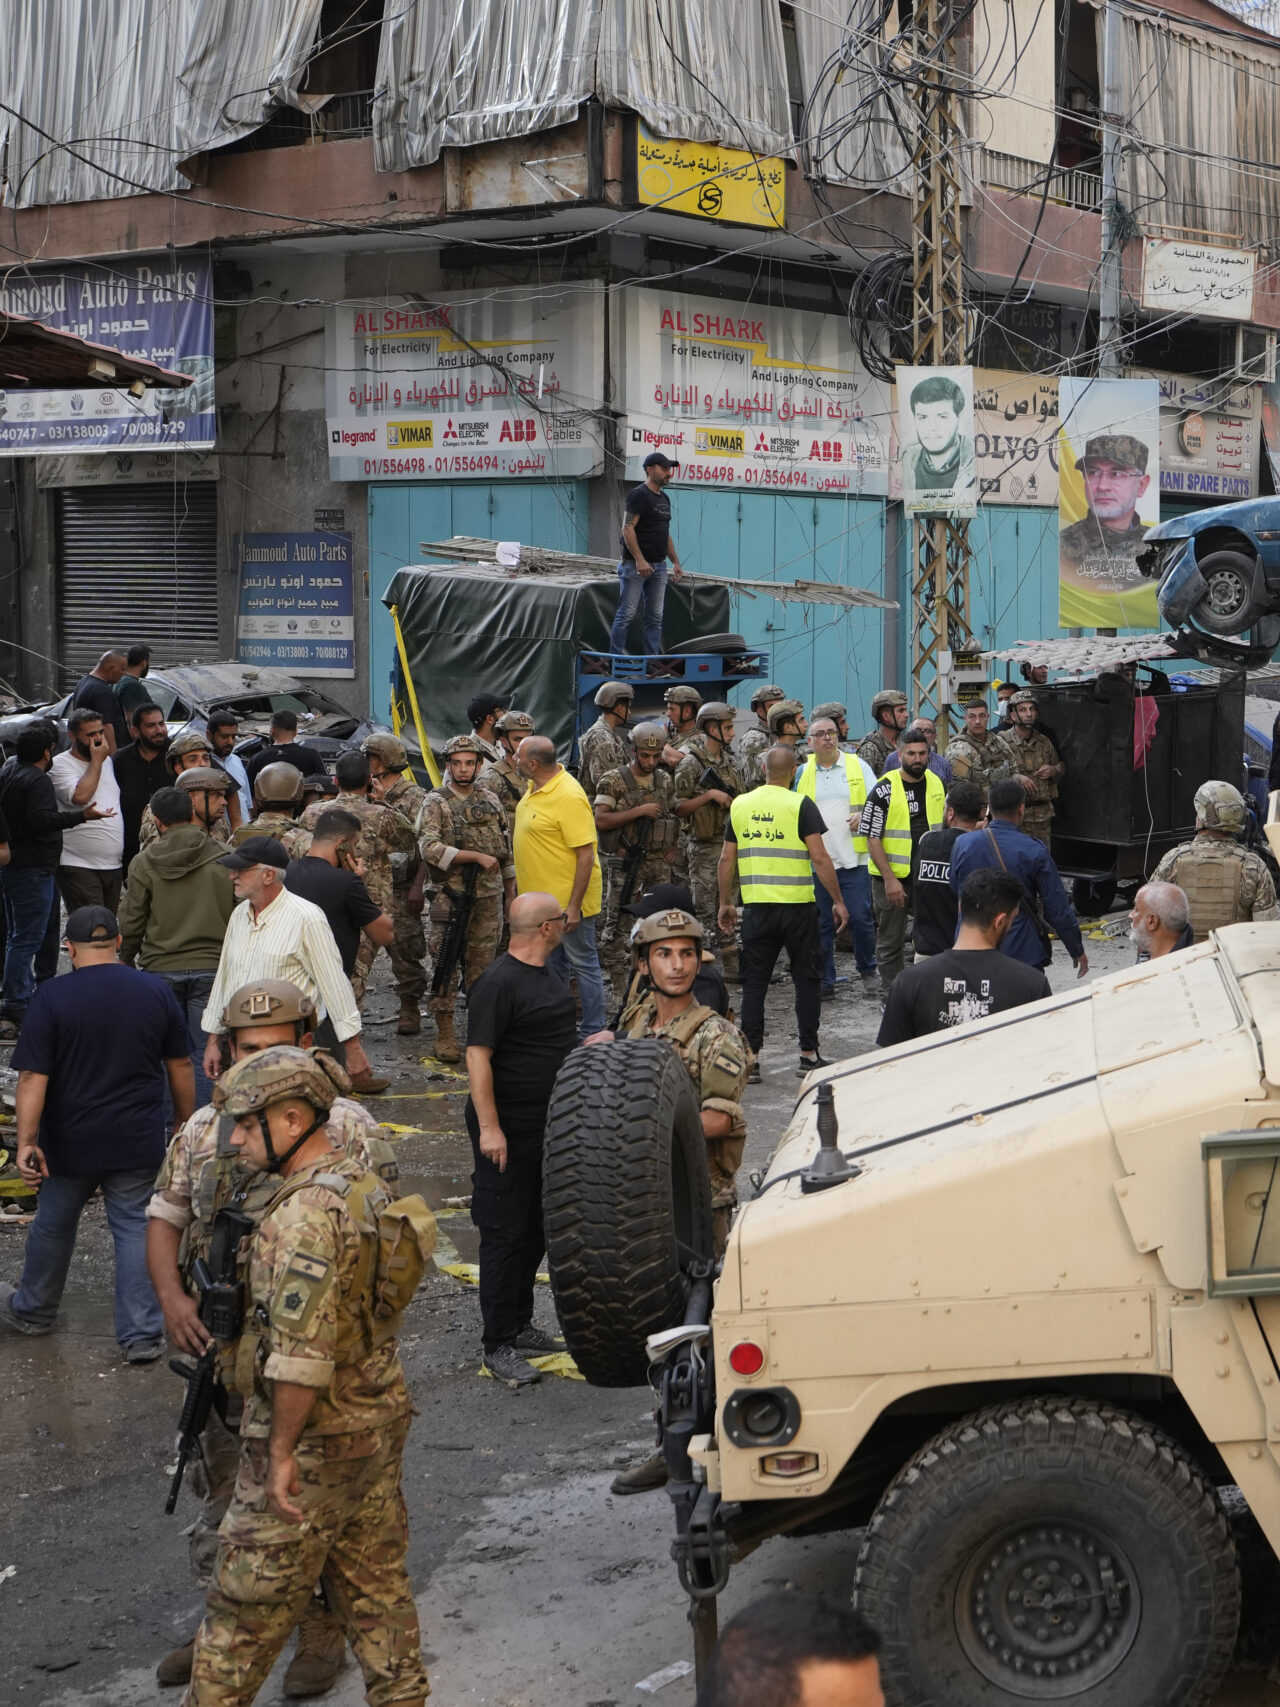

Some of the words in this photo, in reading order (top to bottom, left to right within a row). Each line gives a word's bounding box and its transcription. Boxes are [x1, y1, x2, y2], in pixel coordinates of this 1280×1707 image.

[1174, 247, 1205, 261] اللبنانية
[1207, 252, 1249, 265] الجمهورية
[79, 272, 128, 310] Auto
[136, 264, 197, 305] Parts
[100, 318, 150, 337] حمود
[354, 312, 378, 333] AL
[384, 306, 452, 332] SHARK
[660, 309, 687, 333] AL
[693, 313, 765, 342] SHARK
[364, 345, 379, 356] For
[382, 341, 432, 355] Electricity
[671, 343, 688, 356] For
[691, 346, 745, 365] Electricity
[437, 356, 458, 368] And
[506, 352, 555, 366] Company
[752, 369, 772, 382] And
[775, 371, 814, 388] Lighting
[817, 376, 858, 392] Company
[393, 388, 401, 407] و
[406, 377, 460, 407] للكهرباء
[704, 394, 713, 412] و
[718, 388, 773, 419] للكهرباء
[778, 391, 823, 421] الشرق
[49, 425, 109, 439] 03/138003
[401, 427, 432, 442] VIMAR
[458, 422, 489, 431] MITSUBISHI
[458, 429, 485, 438] ELECTRIC
[499, 419, 537, 443] ABB
[341, 428, 376, 446] legrand
[643, 429, 683, 447] legrand
[710, 433, 743, 451] VIMAR
[770, 437, 800, 447] MITSUBISHI
[1216, 432, 1243, 442] نيسان
[770, 444, 797, 454] ELECTRIC
[809, 440, 843, 463] ABB
[974, 432, 1039, 462] OLVO
[1216, 445, 1242, 456] تويوتا
[364, 458, 425, 475] 01/556498
[435, 455, 499, 473] 01/556494
[508, 454, 546, 475] تليفون
[744, 466, 807, 488] 01/556494
[1187, 473, 1219, 494] SPARE
[1222, 476, 1249, 496] PARTS
[293, 542, 317, 562] Auto
[320, 541, 347, 562] Parts
[242, 574, 276, 590] بارتس
[280, 574, 304, 590] اوتو
[309, 576, 343, 590] حمود
[277, 595, 295, 608] أنواع
[298, 599, 317, 608] جميع
[321, 599, 339, 609] مبيع
[240, 646, 271, 658] 01/542946
[277, 646, 309, 658] 03/138003
[315, 647, 348, 659] 70/088129
[751, 810, 774, 825] بلدية
[765, 828, 784, 842] حارة
[921, 863, 951, 881] POLIC
